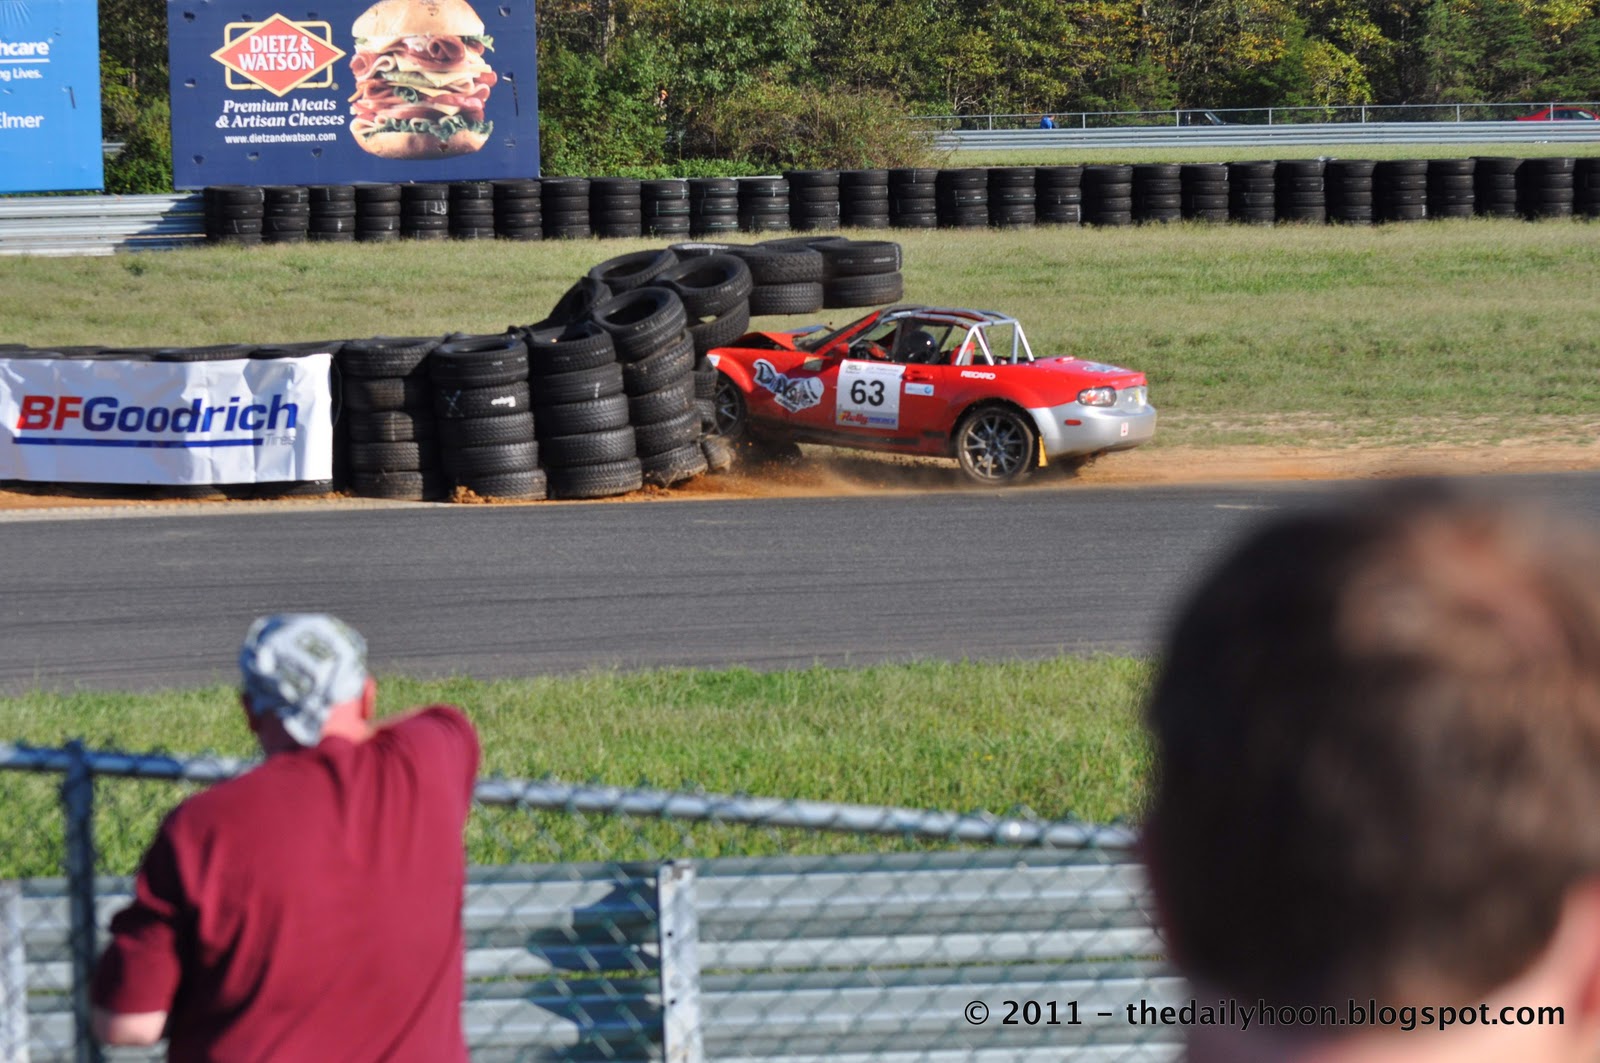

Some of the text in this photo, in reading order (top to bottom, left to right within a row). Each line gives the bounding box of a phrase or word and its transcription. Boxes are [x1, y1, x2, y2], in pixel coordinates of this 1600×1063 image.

[249, 35, 315, 53] DIETZ &
[238, 53, 315, 71] WATSON
[12, 67, 43, 79] Lives.
[223, 98, 337, 113] Premium Meats
[215, 112, 345, 129] & Artisan Cheeses
[224, 132, 337, 144] www.dietzandwatson.com
[850, 379, 885, 407] 63
[16, 394, 299, 433] BFGoodrich
